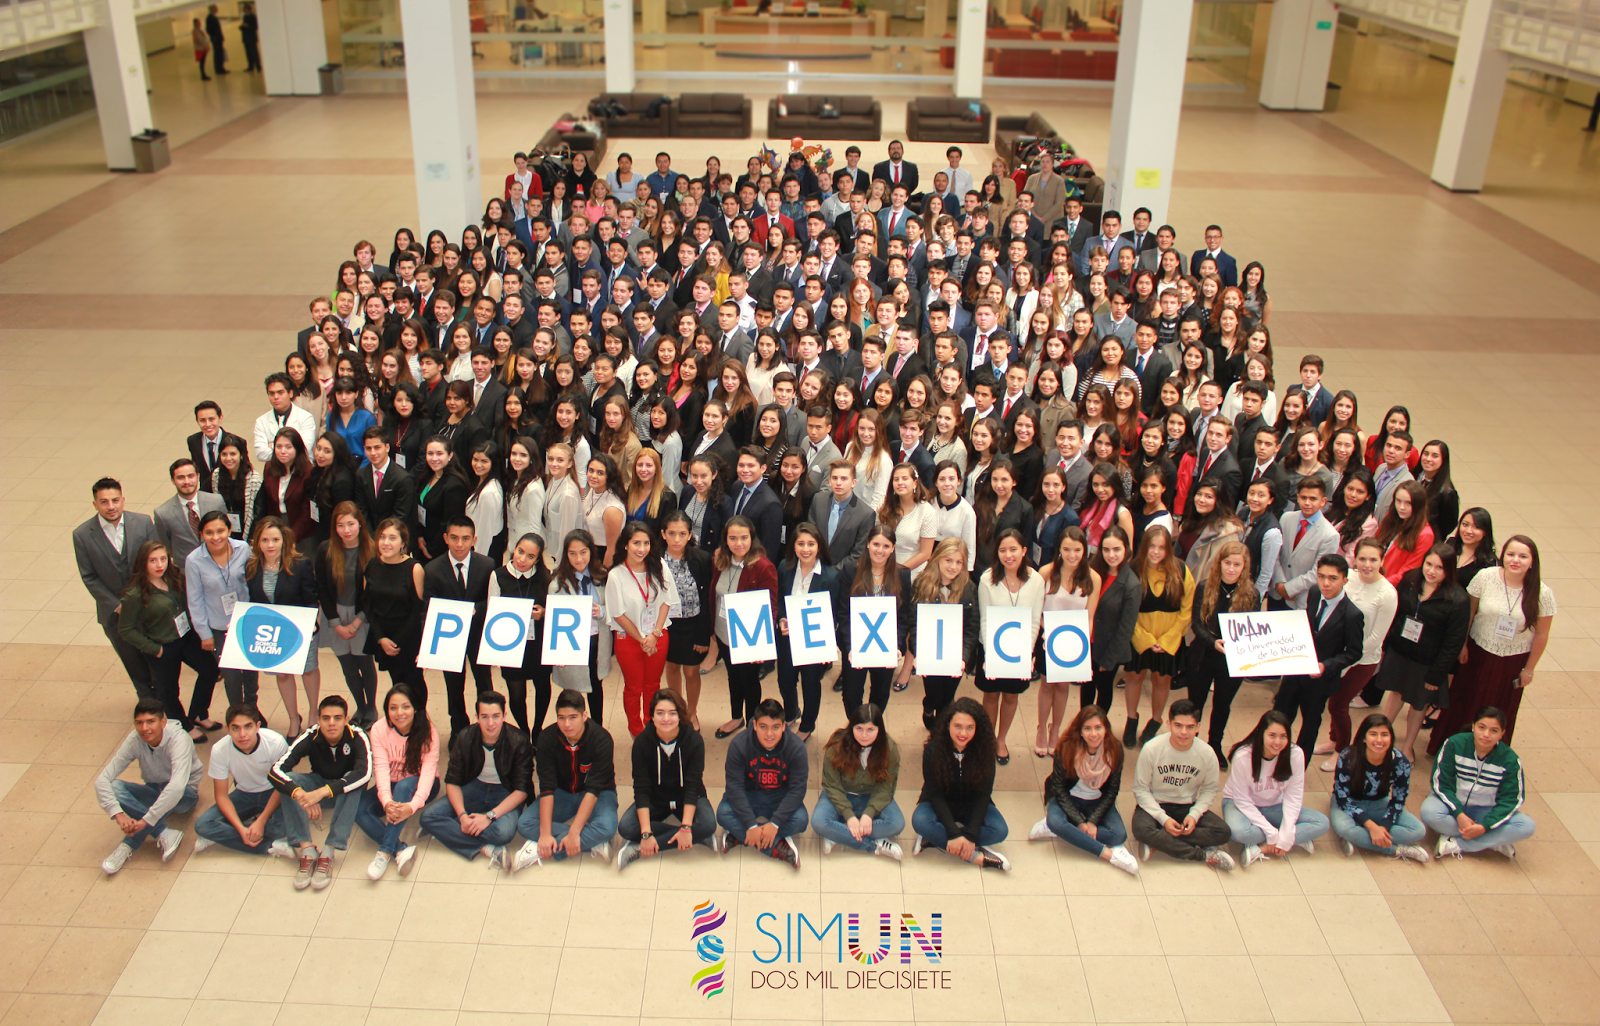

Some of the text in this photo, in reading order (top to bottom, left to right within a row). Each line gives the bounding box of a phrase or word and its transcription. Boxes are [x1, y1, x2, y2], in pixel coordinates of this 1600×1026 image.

[255, 624, 281, 643] SI
[430, 608, 581, 655] POR
[728, 599, 1090, 668] MÉXICO
[249, 644, 283, 656] UNAM
[1248, 634, 1295, 652] Universidad
[1257, 651, 1268, 660] de
[758, 772, 778, 785] 1985
[1157, 763, 1201, 778] DOWNTOWN
